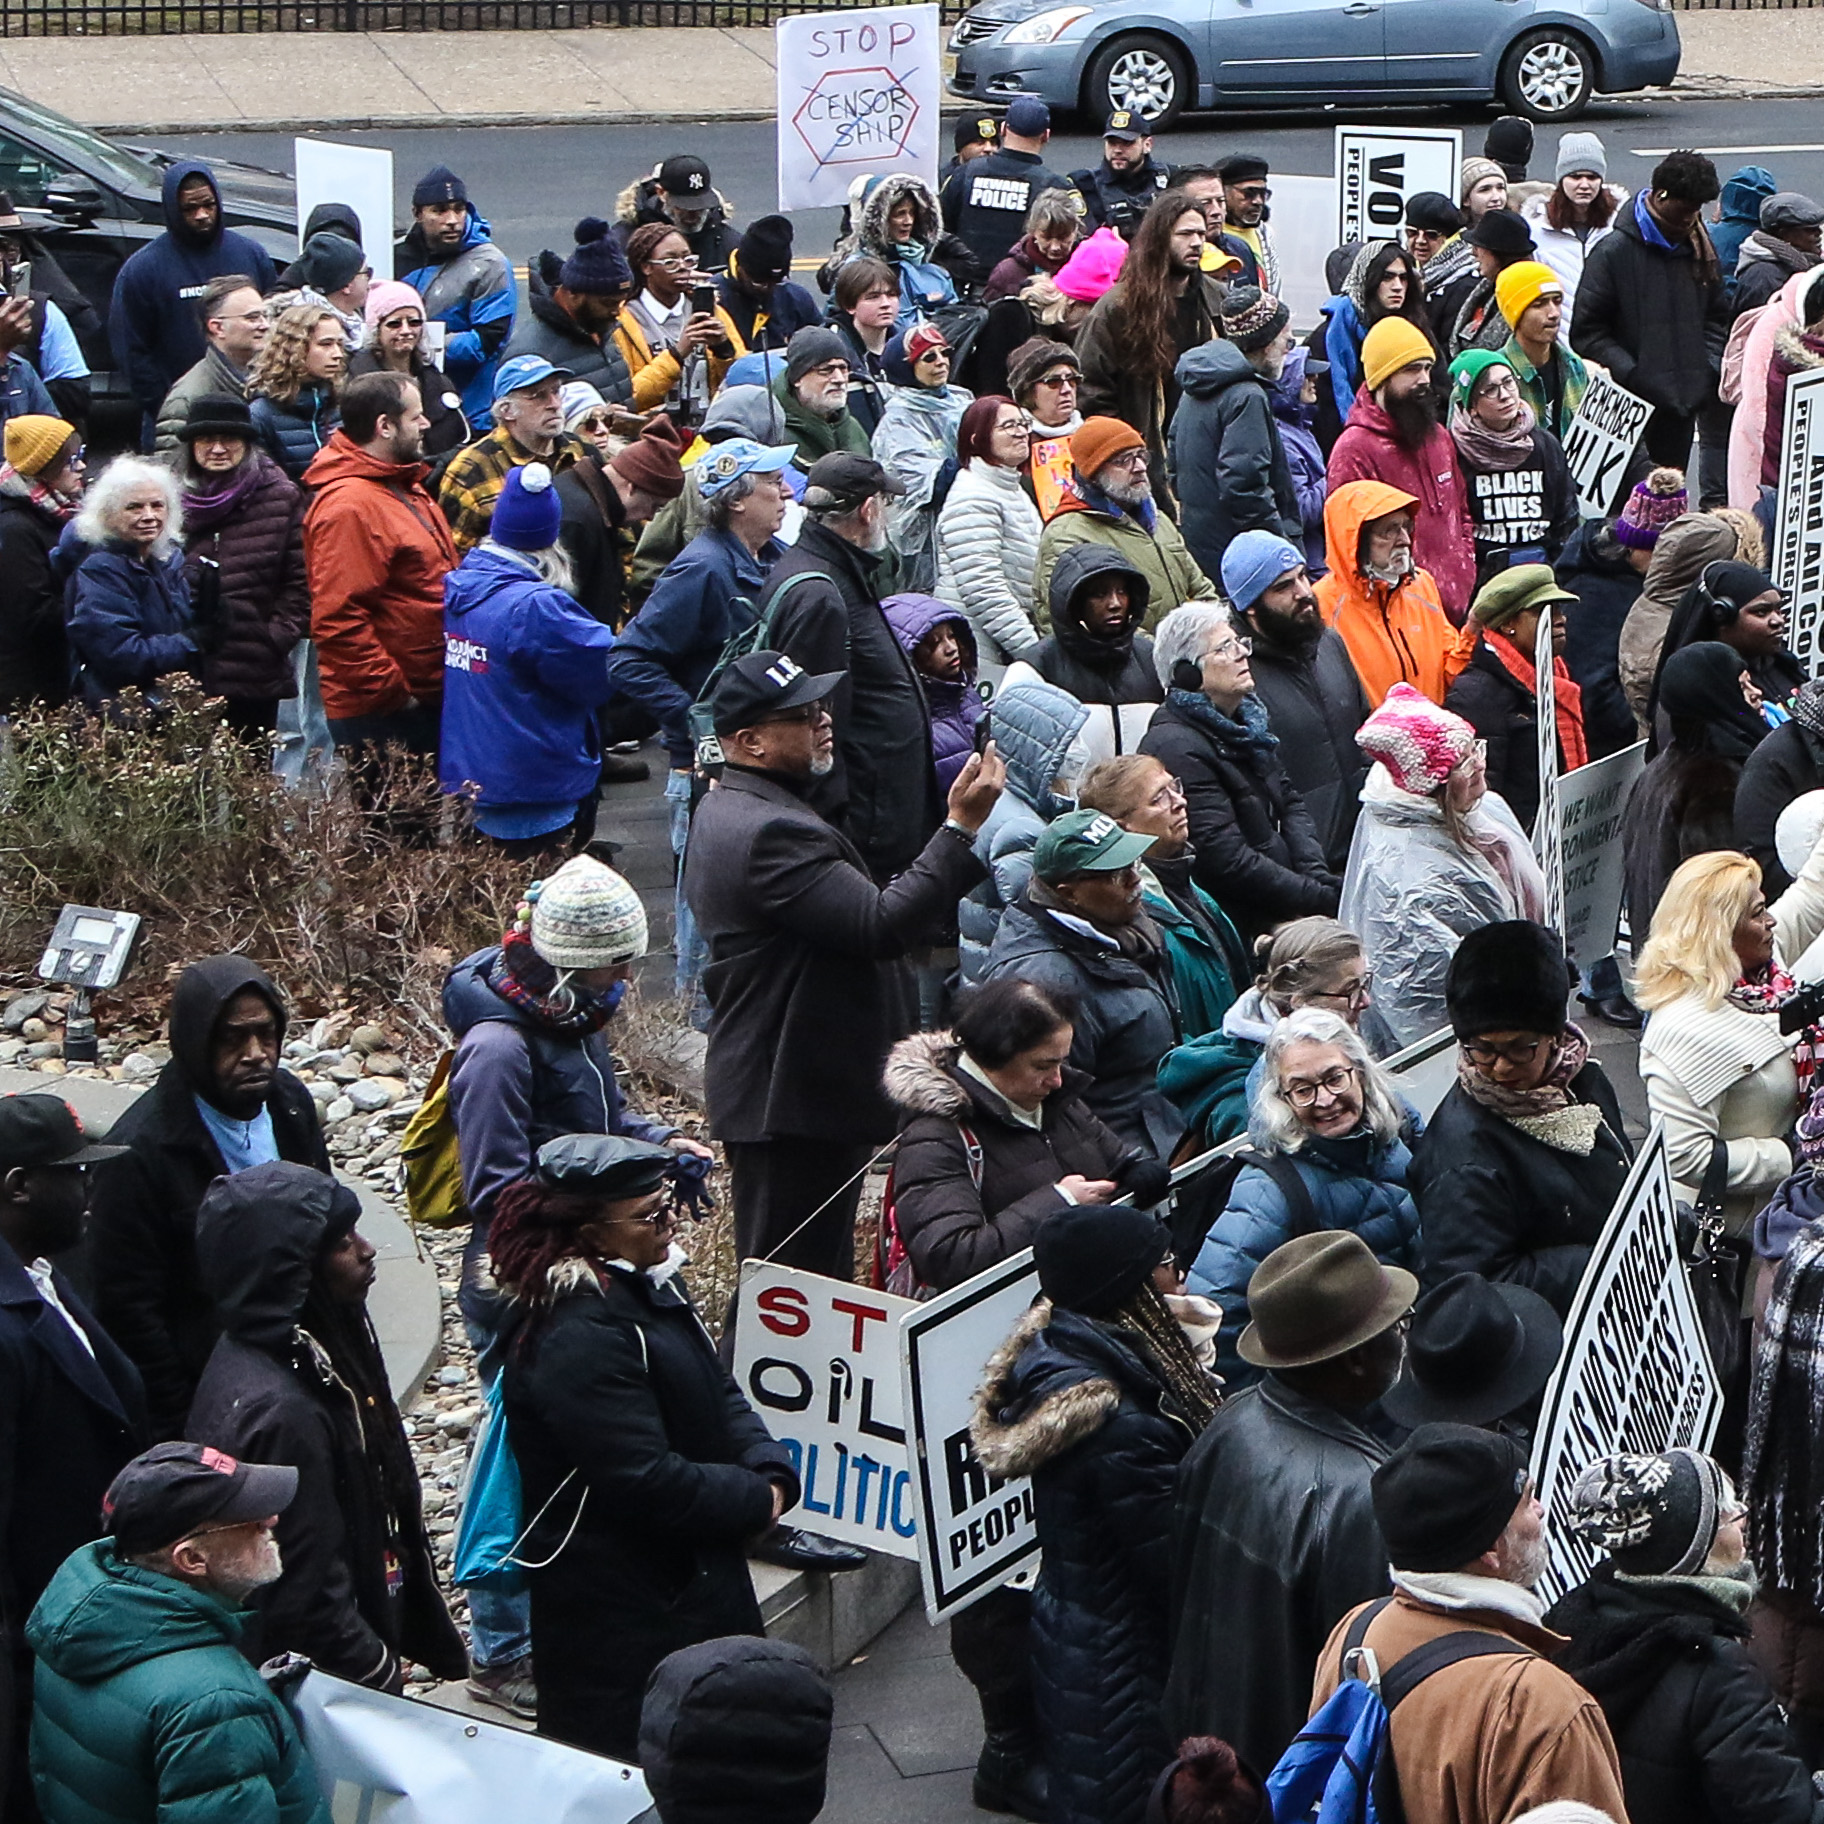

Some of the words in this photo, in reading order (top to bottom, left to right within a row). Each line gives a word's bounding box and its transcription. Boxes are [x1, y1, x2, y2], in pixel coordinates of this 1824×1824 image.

[809, 23, 915, 61] STOP
[808, 87, 911, 120] CENSOR
[835, 114, 904, 147] SHIP
[970, 189, 1028, 212] POLICE
[975, 177, 1030, 193] NEWARK
[1346, 148, 1360, 243] PEOPLE'S
[1578, 376, 1646, 444] REMEMBER
[1566, 428, 1626, 510] MLK
[1787, 399, 1808, 521] PEOPLE'S
[1476, 471, 1544, 497] BLACK
[1483, 494, 1542, 520] LIVES
[1563, 797, 1584, 830] WE
[1597, 1179, 1672, 1404] STRUGGLE
[757, 1286, 888, 1354] ST
[1620, 1278, 1690, 1454] ROGRESS!
